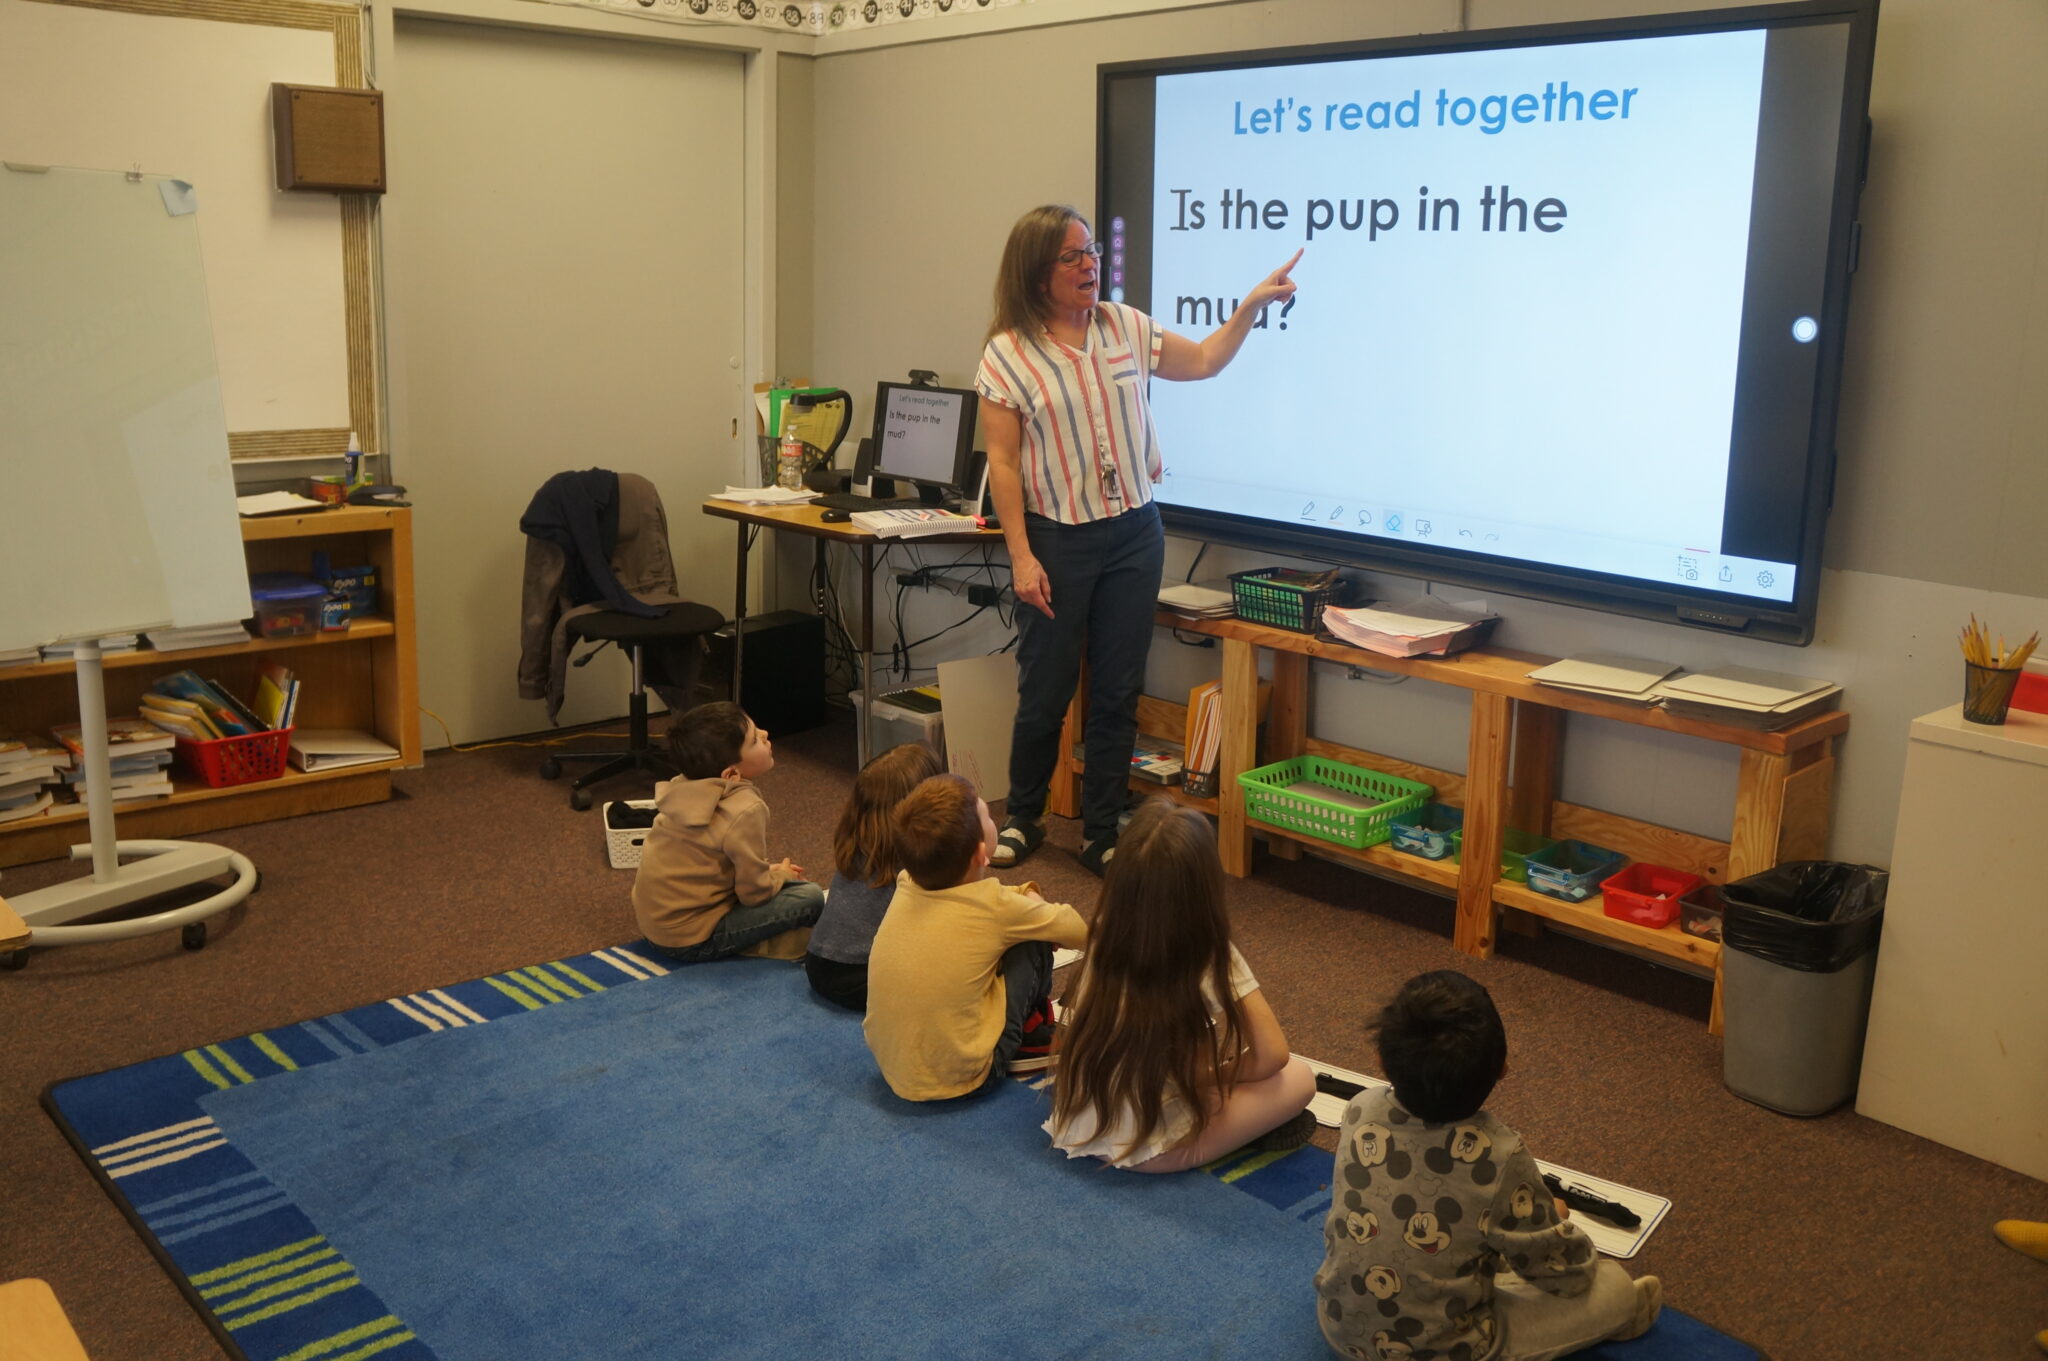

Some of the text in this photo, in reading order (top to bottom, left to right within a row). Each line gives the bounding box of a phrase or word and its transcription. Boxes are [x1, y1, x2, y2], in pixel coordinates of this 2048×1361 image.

[740, 2, 754, 15] 86
[764, 6, 776, 18] 87
[786, 9, 799, 23] 88
[809, 12, 824, 24] 89
[865, 4, 876, 18] 92
[1234, 81, 1639, 135] Let's read together
[1170, 185, 1568, 242] Is the pup in the
[926, 398, 950, 407] together
[889, 410, 941, 424] Is the pup in the
[887, 430, 906, 439] mud?
